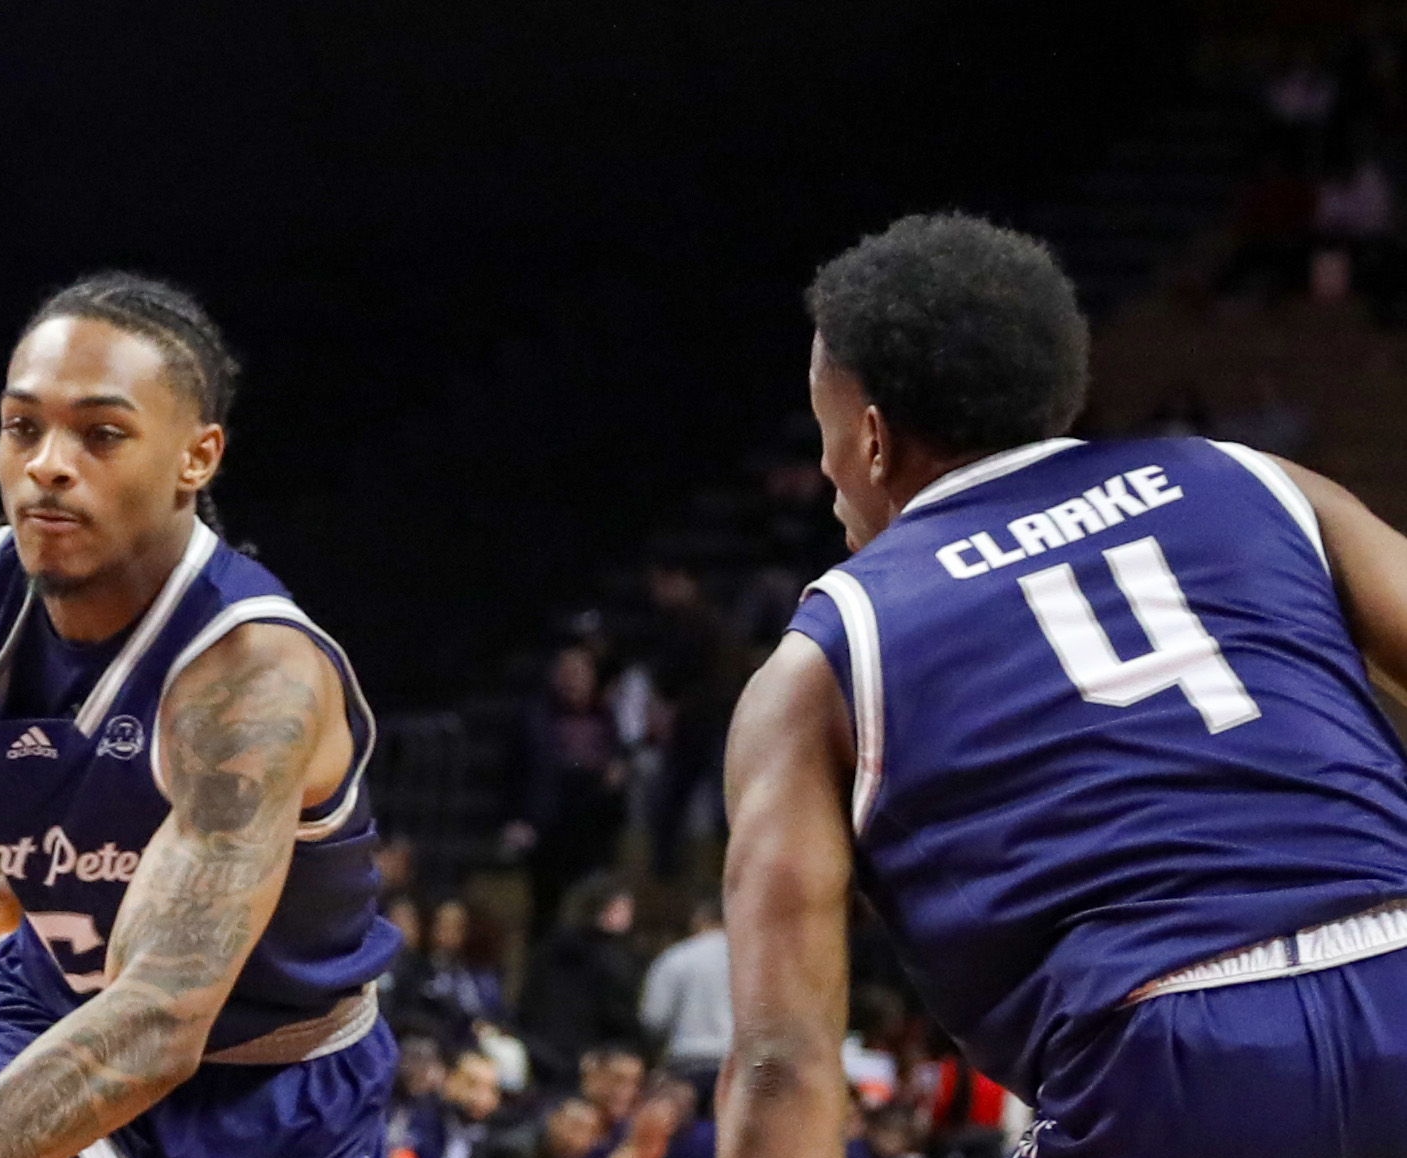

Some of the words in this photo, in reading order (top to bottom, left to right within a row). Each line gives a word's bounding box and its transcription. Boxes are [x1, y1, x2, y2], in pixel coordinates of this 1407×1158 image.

[935, 464, 1185, 580] CLARKE
[1017, 535, 1263, 735] 4
[43, 824, 142, 888] Pete
